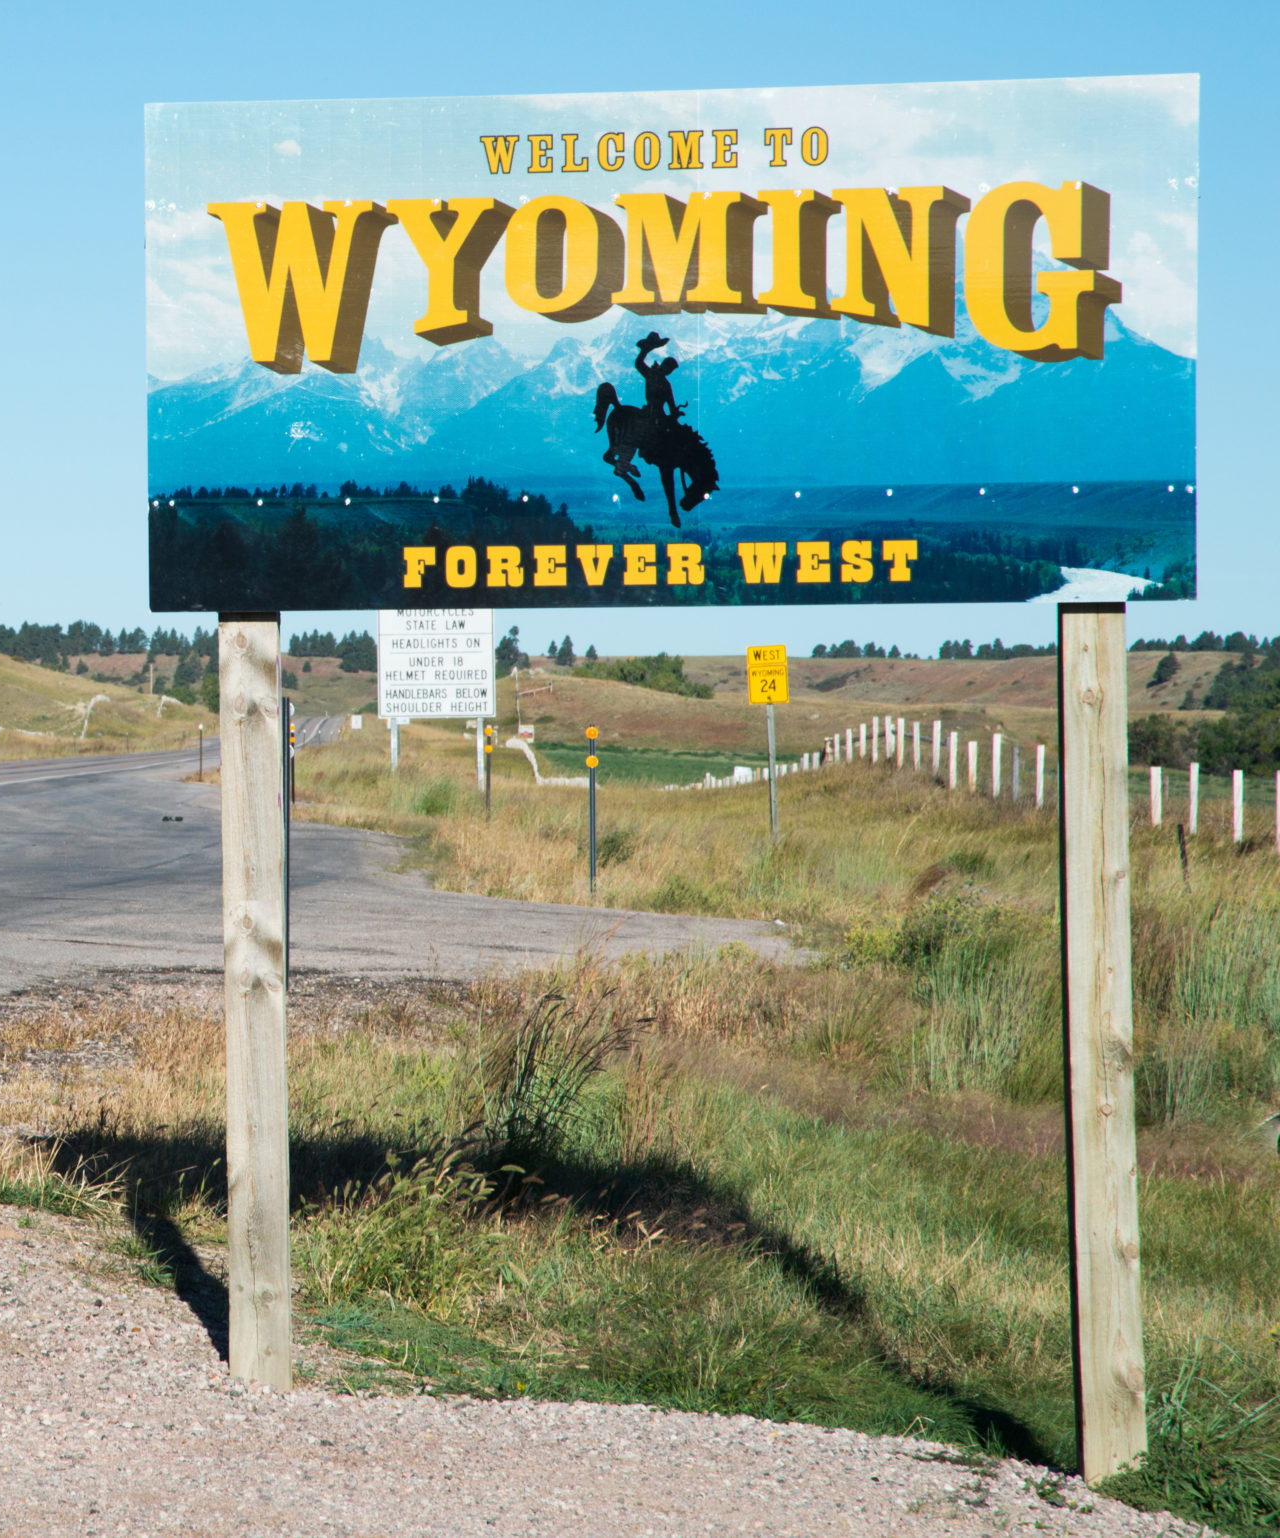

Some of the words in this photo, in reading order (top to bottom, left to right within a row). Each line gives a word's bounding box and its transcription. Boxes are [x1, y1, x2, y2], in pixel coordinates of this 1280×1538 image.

[479, 129, 738, 175] WELCOME
[764, 126, 829, 167] TO
[207, 180, 1122, 375] WYOMING
[403, 544, 705, 588] FOREVER
[737, 539, 918, 583] WEST
[406, 620, 437, 631] STATE
[445, 619, 466, 630] LAW
[392, 638, 457, 649] HEADLIGHTS
[466, 637, 480, 648] ON
[753, 649, 780, 661] WEST
[409, 656, 444, 668] UNDER
[453, 656, 464, 667] 18
[385, 670, 426, 681] HELMET
[434, 669, 488, 680] REQUIRED
[752, 669, 784, 677] WYOMING
[760, 678, 776, 693] 24
[385, 688, 447, 700] HANDLEBARS
[455, 687, 488, 699] BELOW
[386, 702, 442, 713] SHOULDER
[450, 701, 488, 712] HEIGHT
